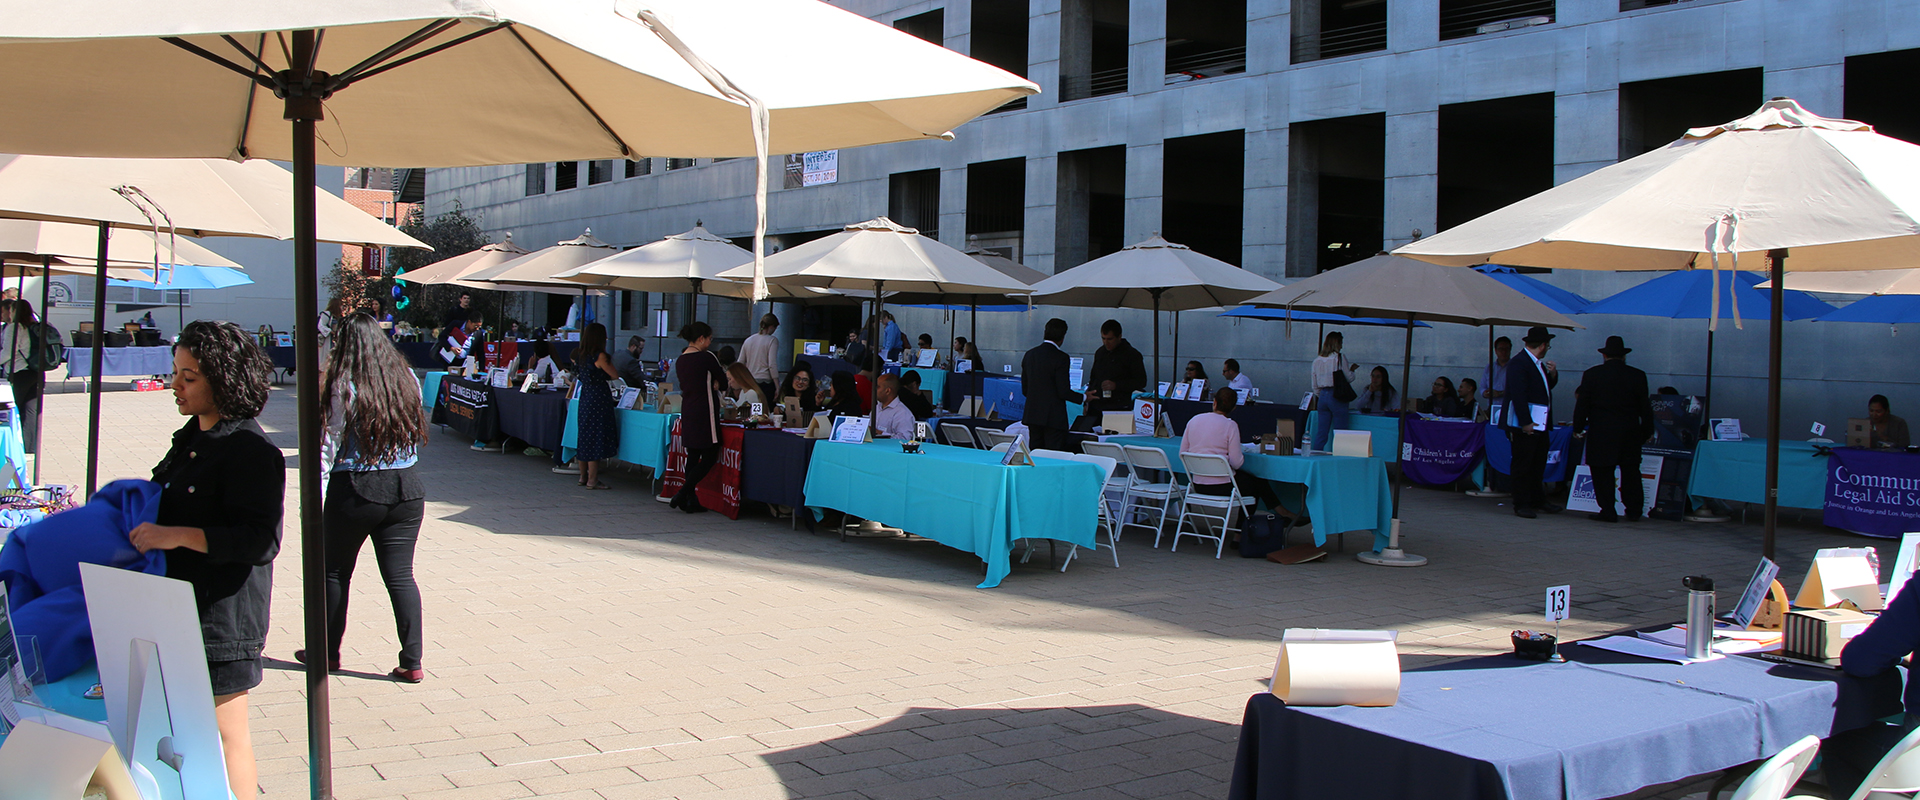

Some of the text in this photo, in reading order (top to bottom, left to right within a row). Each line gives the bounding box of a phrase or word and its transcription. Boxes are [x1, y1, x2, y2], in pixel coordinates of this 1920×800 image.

[806, 152, 835, 163] INTEREST
[806, 163, 820, 171] FAIR
[823, 171, 836, 181] 2019
[753, 404, 761, 412] 23
[1815, 424, 1822, 433] 8
[1413, 447, 1442, 457] Children's
[49, 487, 63, 501] 15
[1834, 483, 1871, 504] Legal
[1875, 489, 1901, 505] Aid
[1828, 501, 1846, 509] Justice
[1847, 503, 1854, 511] in
[1854, 505, 1875, 515] Orange
[1550, 589, 1565, 612] 13
